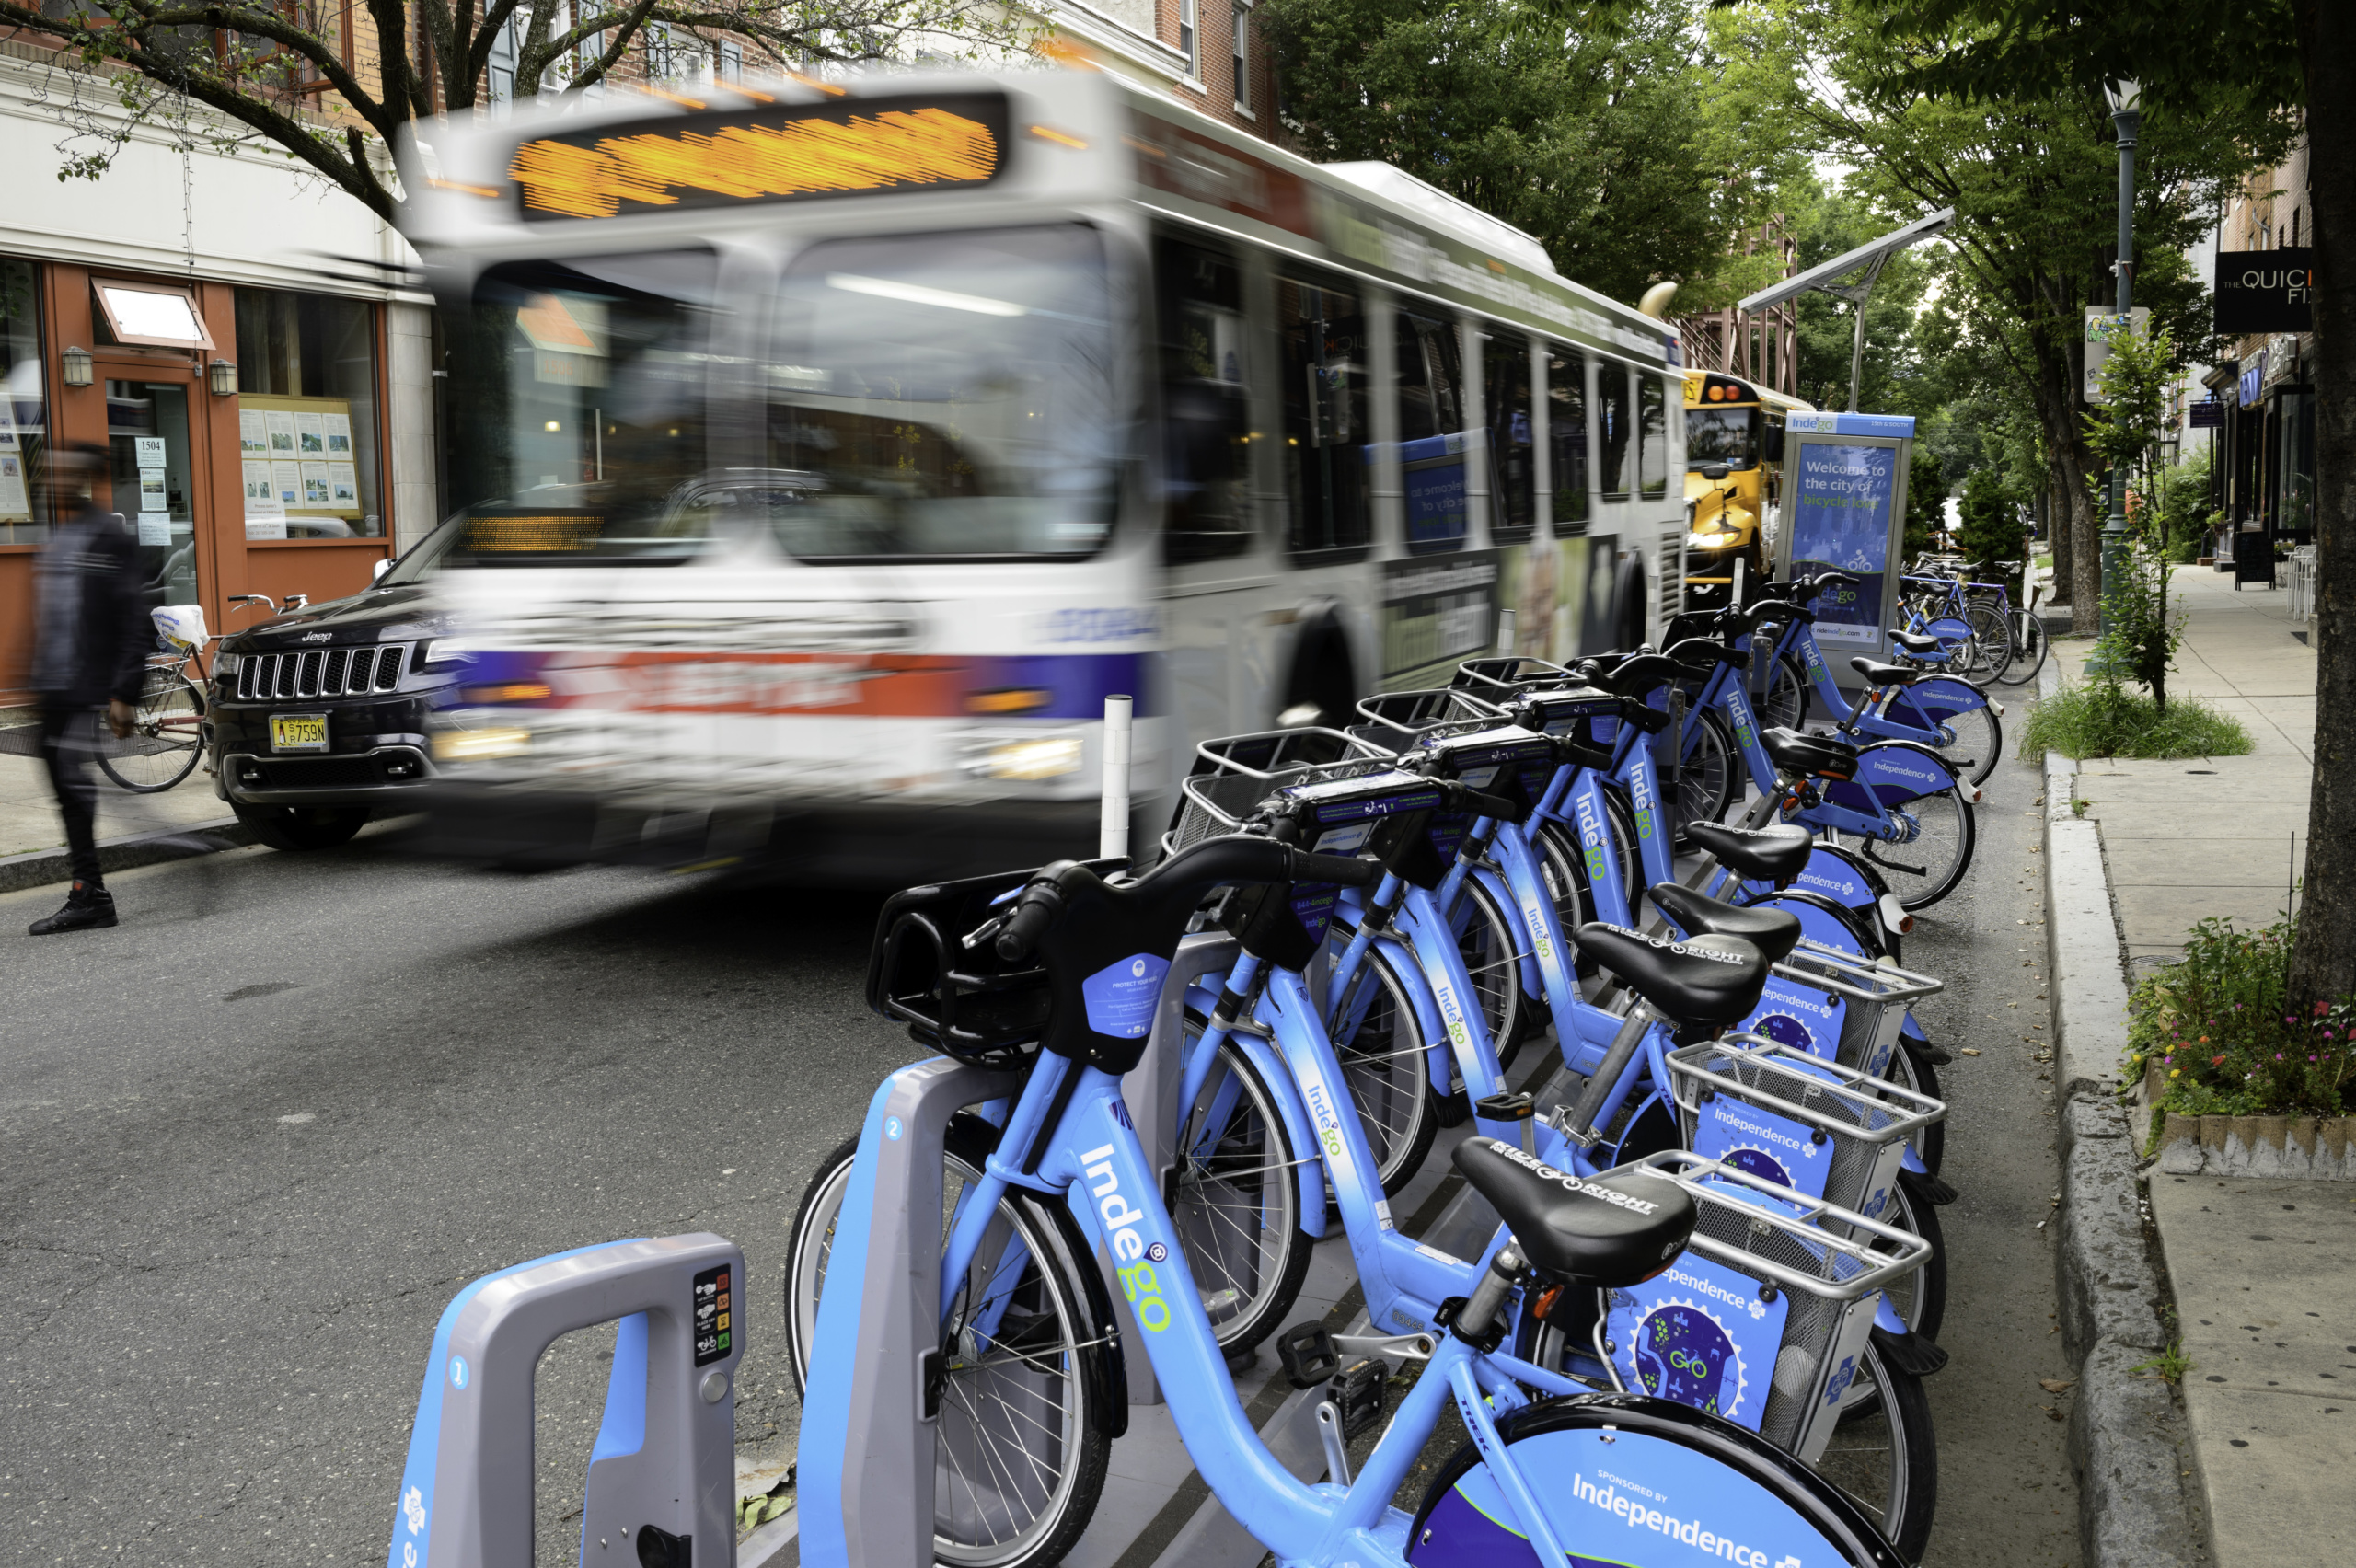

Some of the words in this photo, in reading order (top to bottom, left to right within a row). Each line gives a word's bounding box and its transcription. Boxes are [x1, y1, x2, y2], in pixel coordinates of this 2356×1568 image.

[2223, 281, 2242, 289] THE
[2288, 288, 2312, 305] FI
[544, 359, 573, 376] 1506
[1792, 418, 1833, 432] Indego
[142, 441, 161, 451] 1504
[1807, 461, 1867, 476] Welcome
[1872, 466, 1886, 477] to
[1805, 478, 1827, 490] the
[1830, 479, 1854, 493] city
[1858, 480, 1873, 492] of
[1804, 493, 1848, 509] bicycle
[1853, 495, 1878, 510] love
[302, 631, 332, 642] Jeep
[1801, 640, 1826, 682] Indego
[1923, 690, 1965, 702] Independence
[1727, 690, 1753, 747] Indego
[295, 724, 325, 742] 759N
[1874, 761, 1926, 778] Independence
[1630, 762, 1652, 839] Indego
[1576, 792, 1605, 881] Indego
[1797, 872, 1841, 890] pendence
[1297, 896, 1333, 909] 844-4indego
[1306, 917, 1325, 928] Indego
[1528, 908, 1550, 958] Indego
[1620, 929, 1648, 942] COMFORT
[1687, 946, 1744, 962] RIGHT
[1113, 980, 1136, 989] PROTECT
[1438, 986, 1465, 1044] Indego
[889, 1120, 897, 1136] 2
[1308, 1085, 1341, 1156] Indego
[1715, 1108, 1800, 1150] Independence
[1489, 1145, 1505, 1154] FOR
[1504, 1151, 1537, 1170] COMFORT
[1493, 1141, 1543, 1167] RIDE
[1584, 1183, 1659, 1210] RIGHT
[1624, 1204, 1652, 1215] SADDLE
[1080, 1143, 1171, 1332] Indego
[1661, 1268, 1745, 1309] ependence
[1392, 1311, 1424, 1333] 03445
[1439, 1308, 1449, 1320] OPEN
[1461, 1395, 1491, 1453] TREK
[1598, 1469, 1653, 1498] SPONSORED
[1655, 1493, 1668, 1504] BY
[1573, 1472, 1768, 1568] Independence
